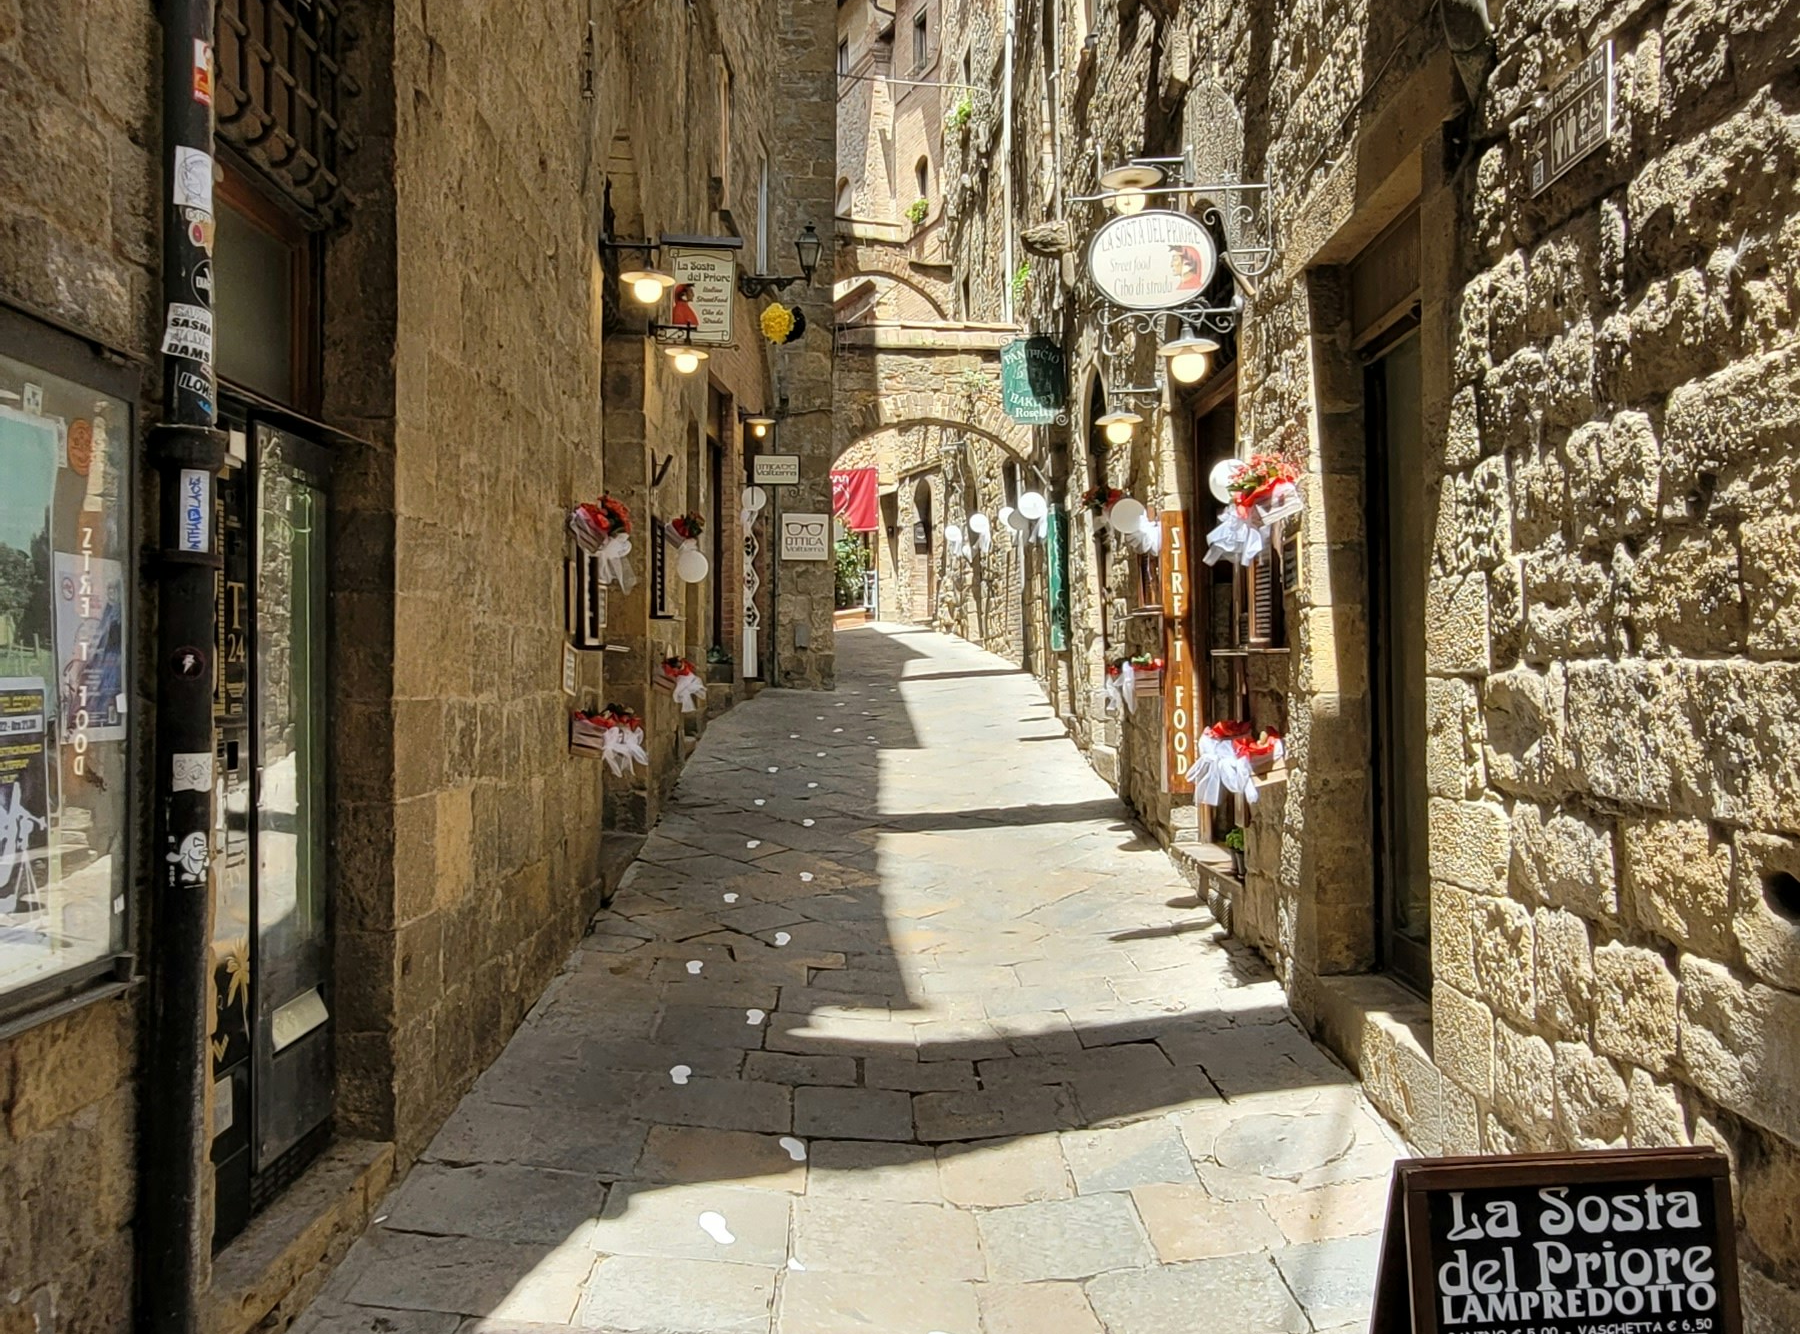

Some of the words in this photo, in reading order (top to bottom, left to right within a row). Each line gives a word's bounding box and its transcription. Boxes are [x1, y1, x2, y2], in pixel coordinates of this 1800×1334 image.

[1115, 219, 1146, 249] SOSTA
[1146, 217, 1166, 244] DEL
[1166, 218, 1201, 245] PRIORE
[677, 260, 689, 271] La
[690, 260, 716, 272] Sosta
[687, 272, 702, 282] del
[703, 272, 731, 283] Priore
[1132, 255, 1152, 275] food
[1114, 277, 1134, 297] Cibo
[1135, 276, 1145, 296] di
[785, 536, 824, 546] OTTICA
[1170, 526, 1184, 662] STREET
[227, 633, 246, 663] 24
[1173, 685, 1188, 776] FOOD
[1446, 1191, 1521, 1241] La
[1538, 1183, 1702, 1236] Sosta
[1438, 1246, 1520, 1296] del
[1532, 1240, 1715, 1293] Priore
[1441, 1282, 1717, 1325] LAMPREDOTTO
[1666, 1320, 1677, 1332] €
